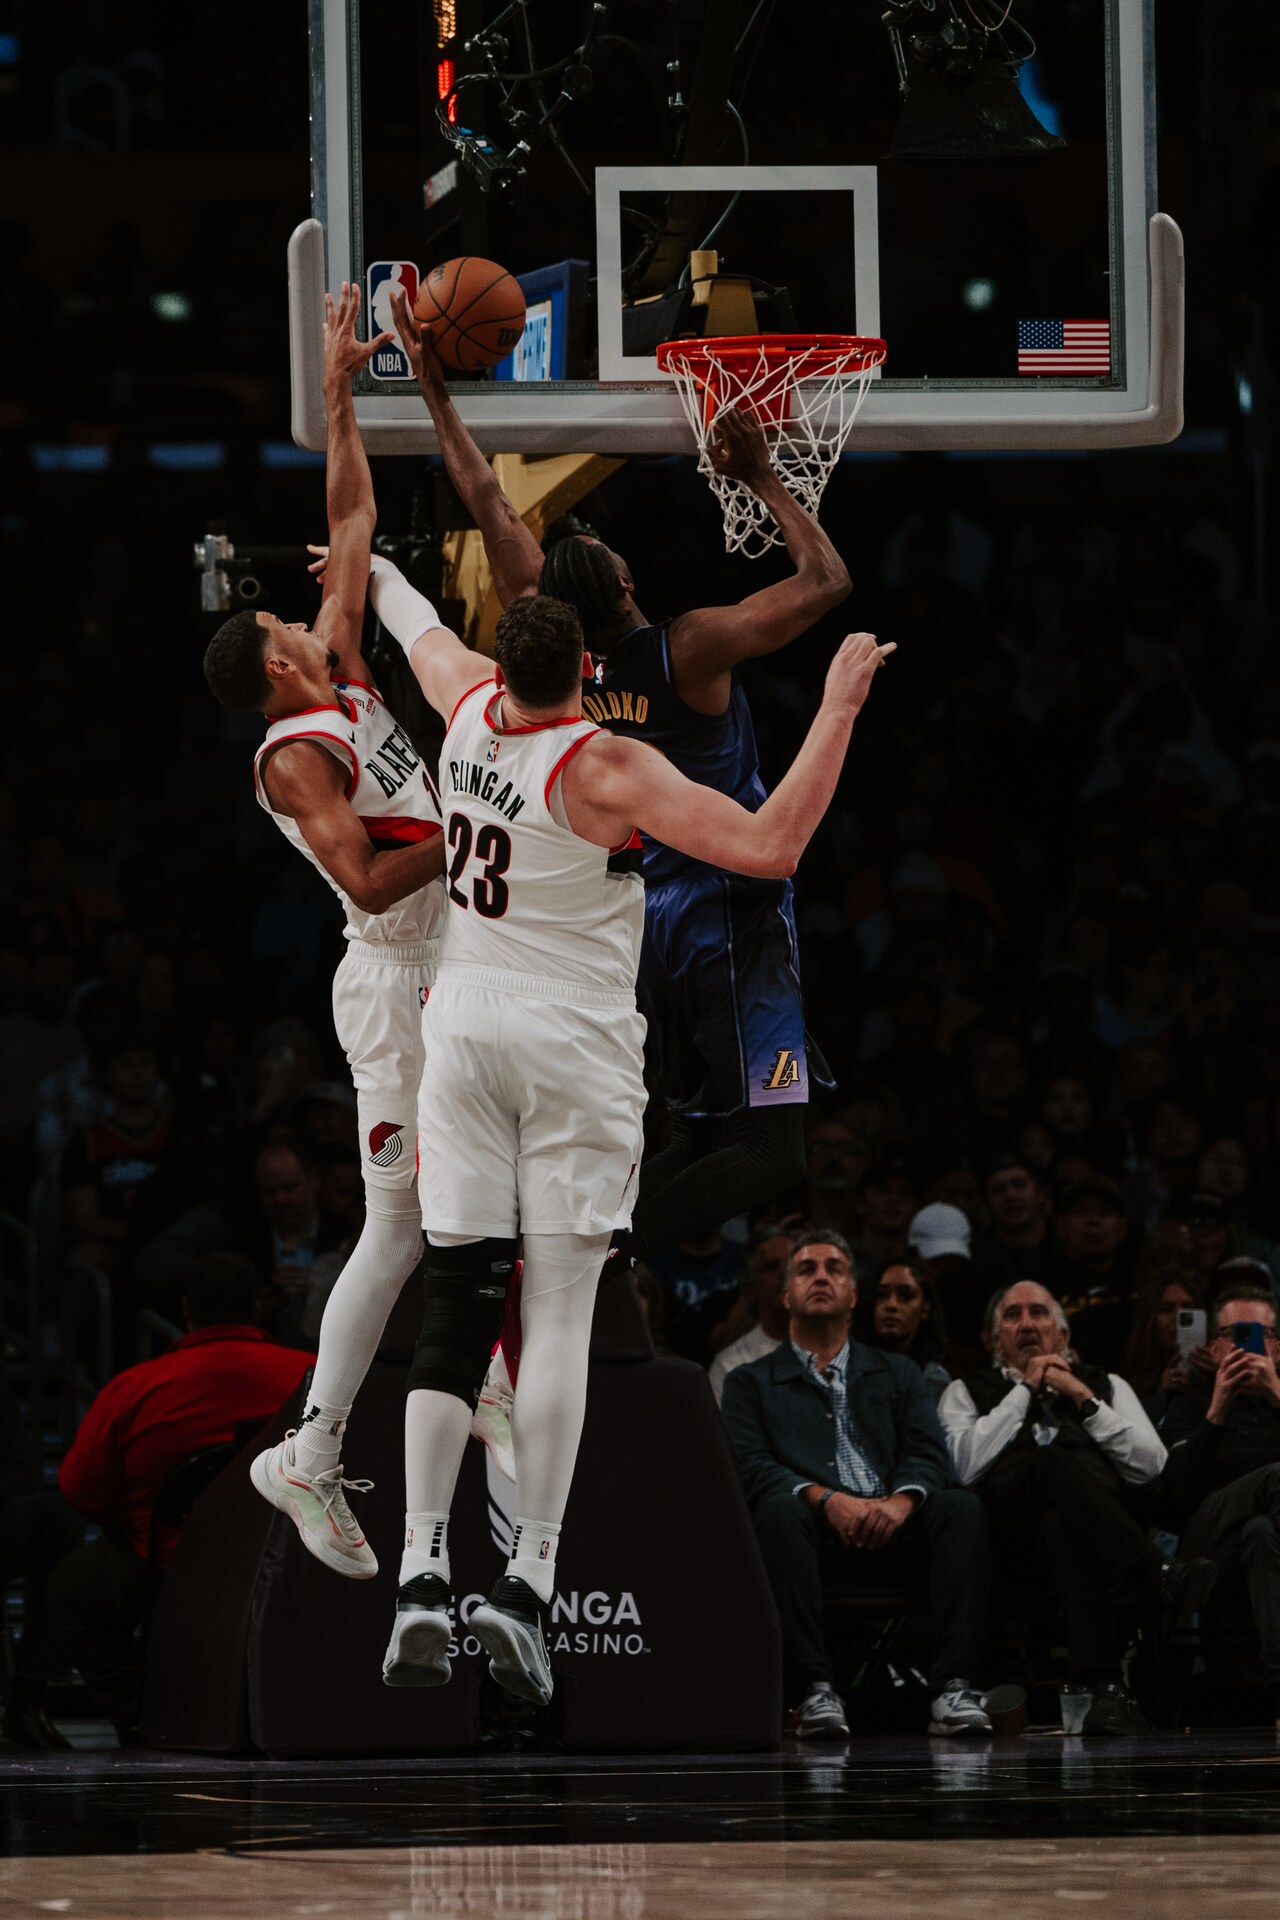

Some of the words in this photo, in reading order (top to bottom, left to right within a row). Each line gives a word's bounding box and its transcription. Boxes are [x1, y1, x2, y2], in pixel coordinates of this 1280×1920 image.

[377, 353, 403, 372] NBA
[581, 690, 649, 725] OLOKO
[449, 760, 525, 822] CLINGAN
[448, 812, 512, 919] 23
[763, 1049, 800, 1090] LA
[547, 1632, 644, 1655] ASINO
